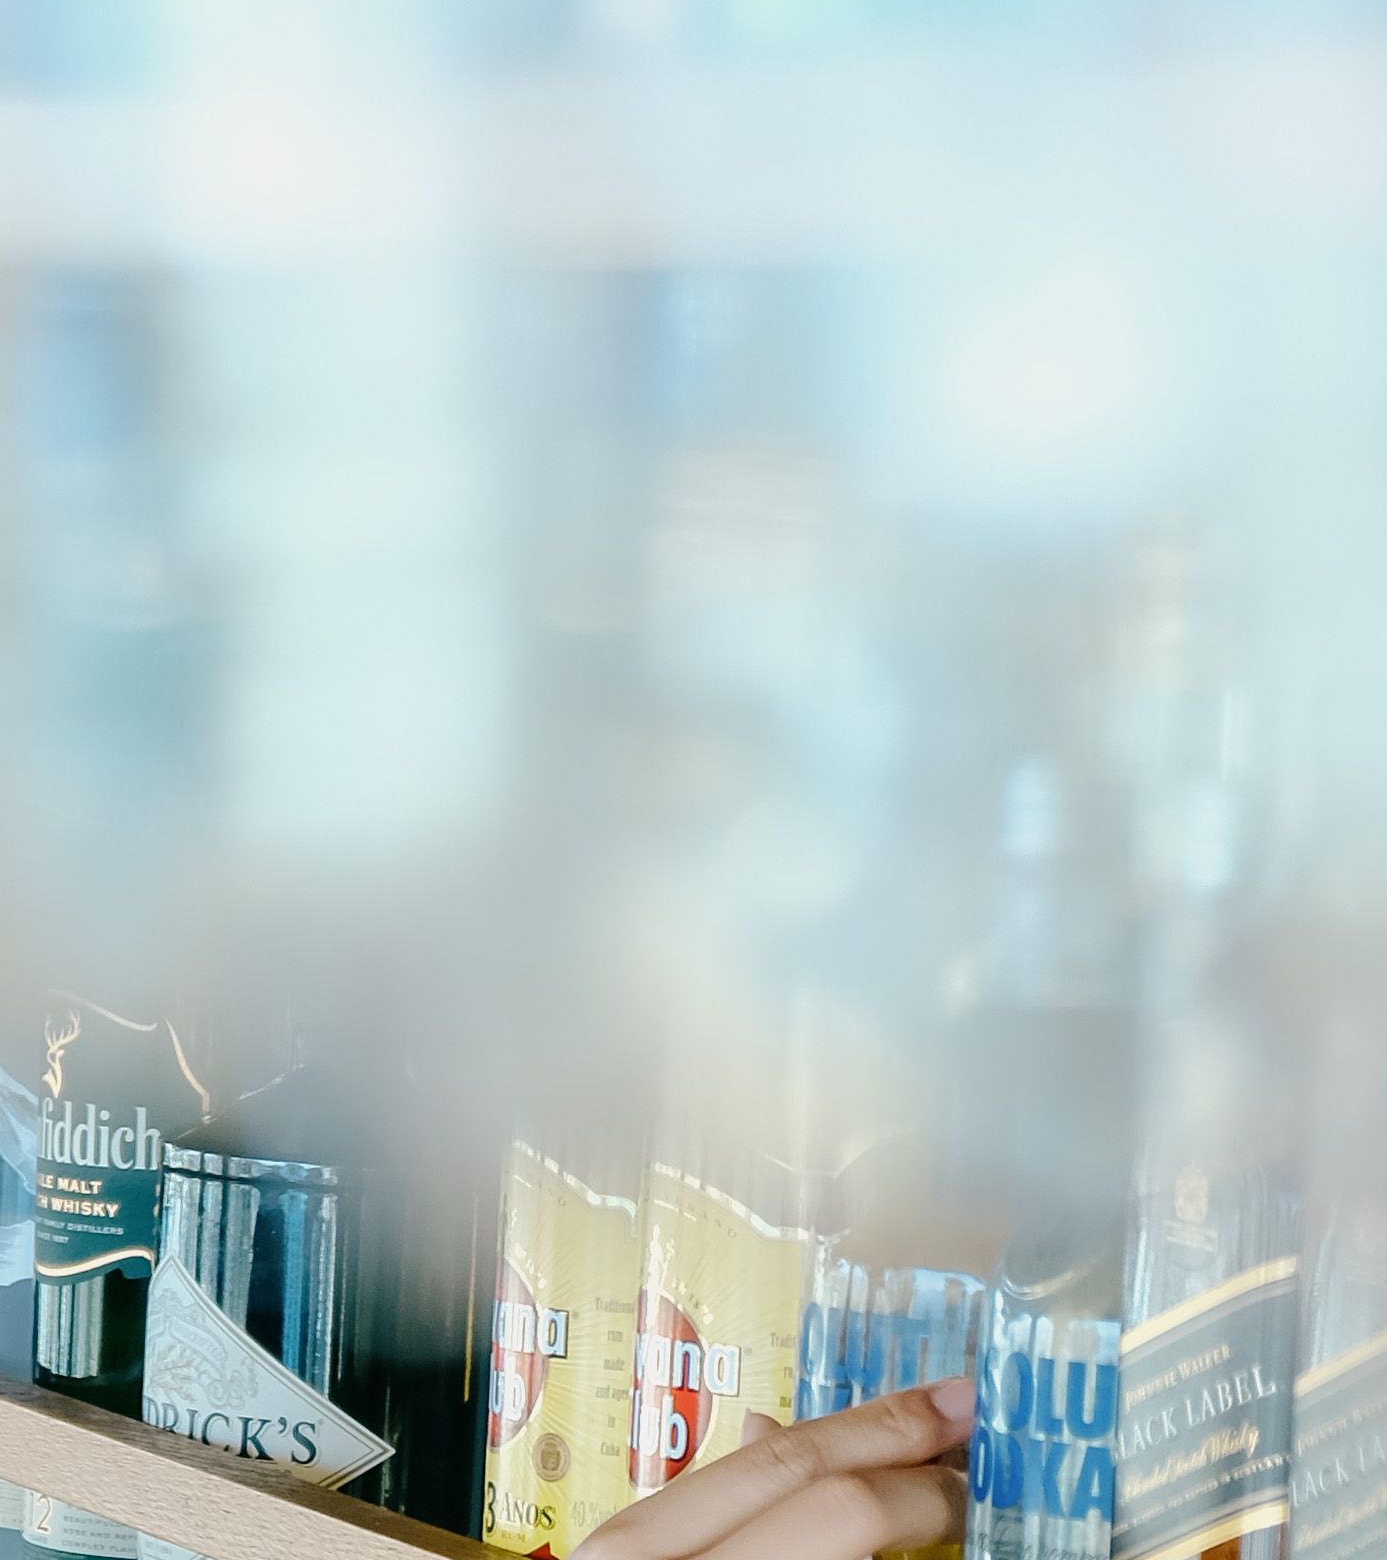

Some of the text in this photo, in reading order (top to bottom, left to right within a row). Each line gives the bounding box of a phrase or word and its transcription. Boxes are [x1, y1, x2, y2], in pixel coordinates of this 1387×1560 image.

[56, 1176, 103, 1195] MALT
[50, 1196, 121, 1218] WHISKY
[1185, 1365, 1278, 1428] LABEL
